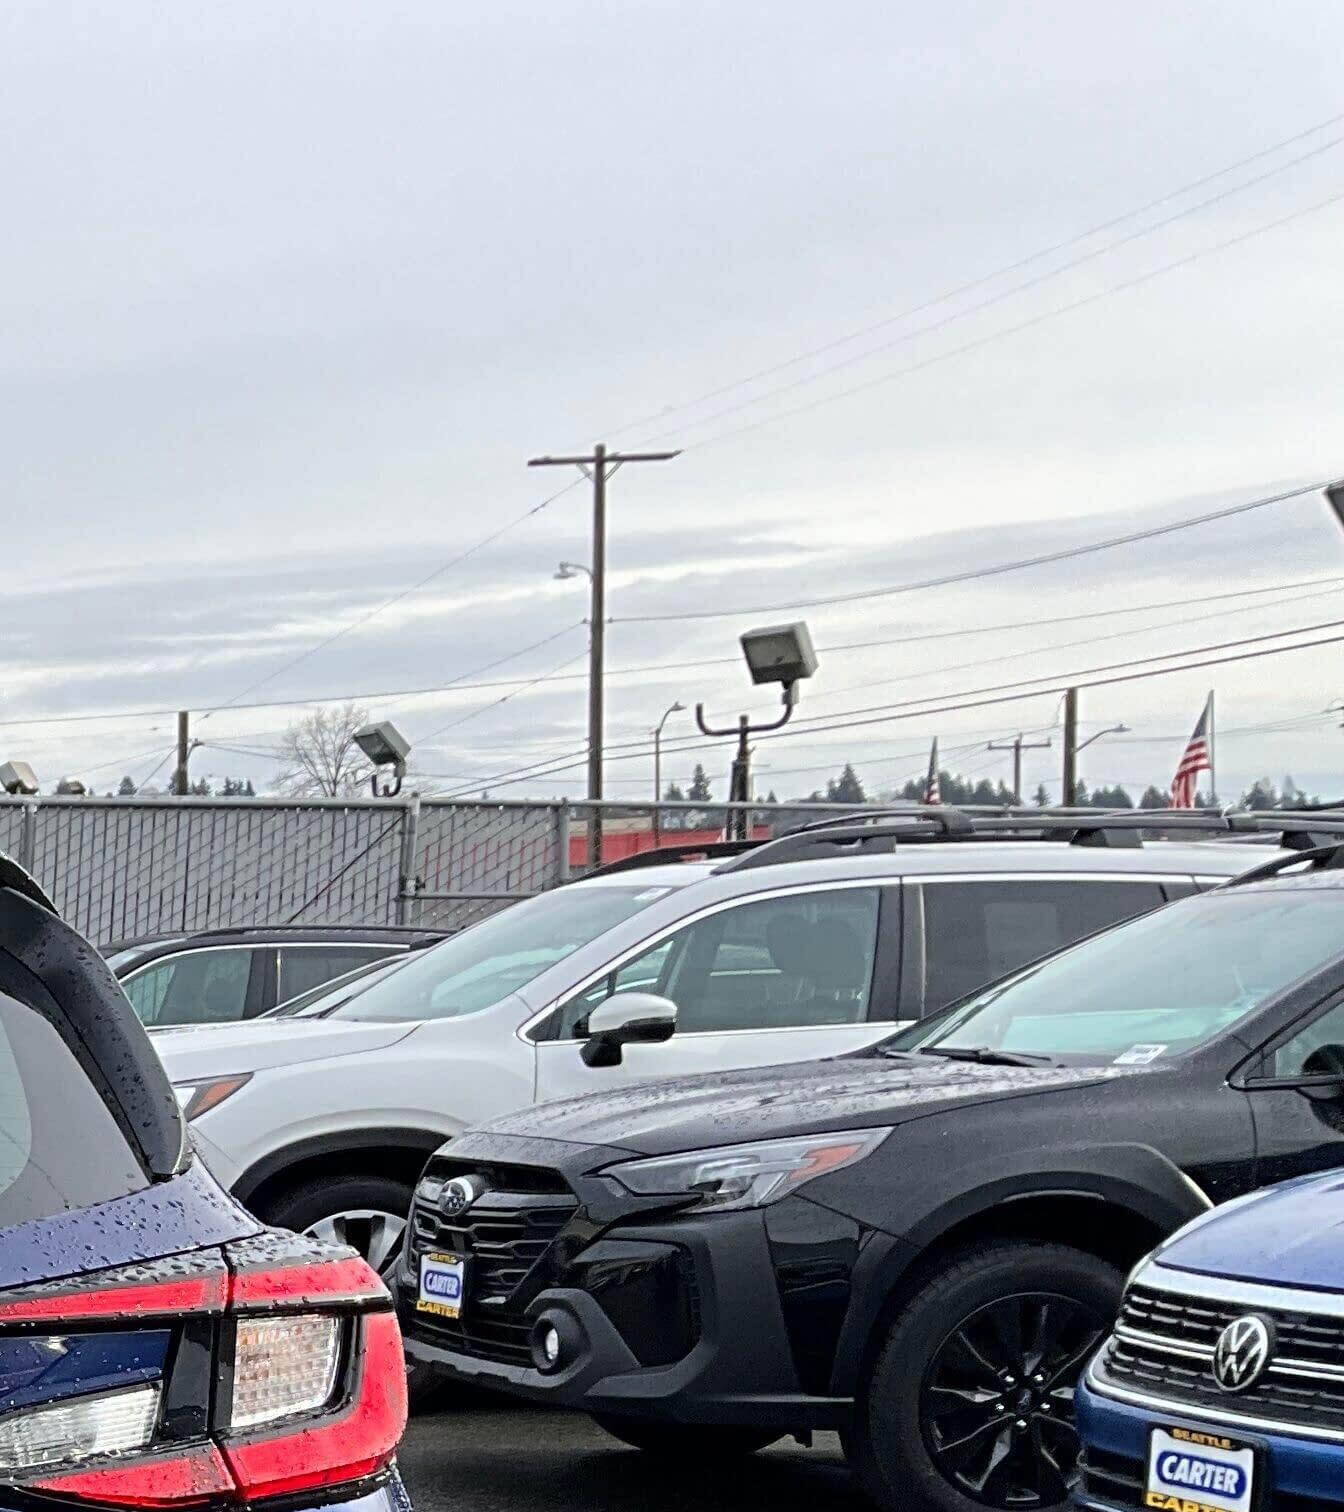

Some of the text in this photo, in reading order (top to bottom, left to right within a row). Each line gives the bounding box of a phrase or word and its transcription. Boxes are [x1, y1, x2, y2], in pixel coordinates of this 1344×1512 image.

[425, 1272, 458, 1297] CARTER
[416, 1300, 460, 1319] CARTER
[1172, 1427, 1231, 1450] SEATTLE
[1161, 1455, 1239, 1494] CARTER
